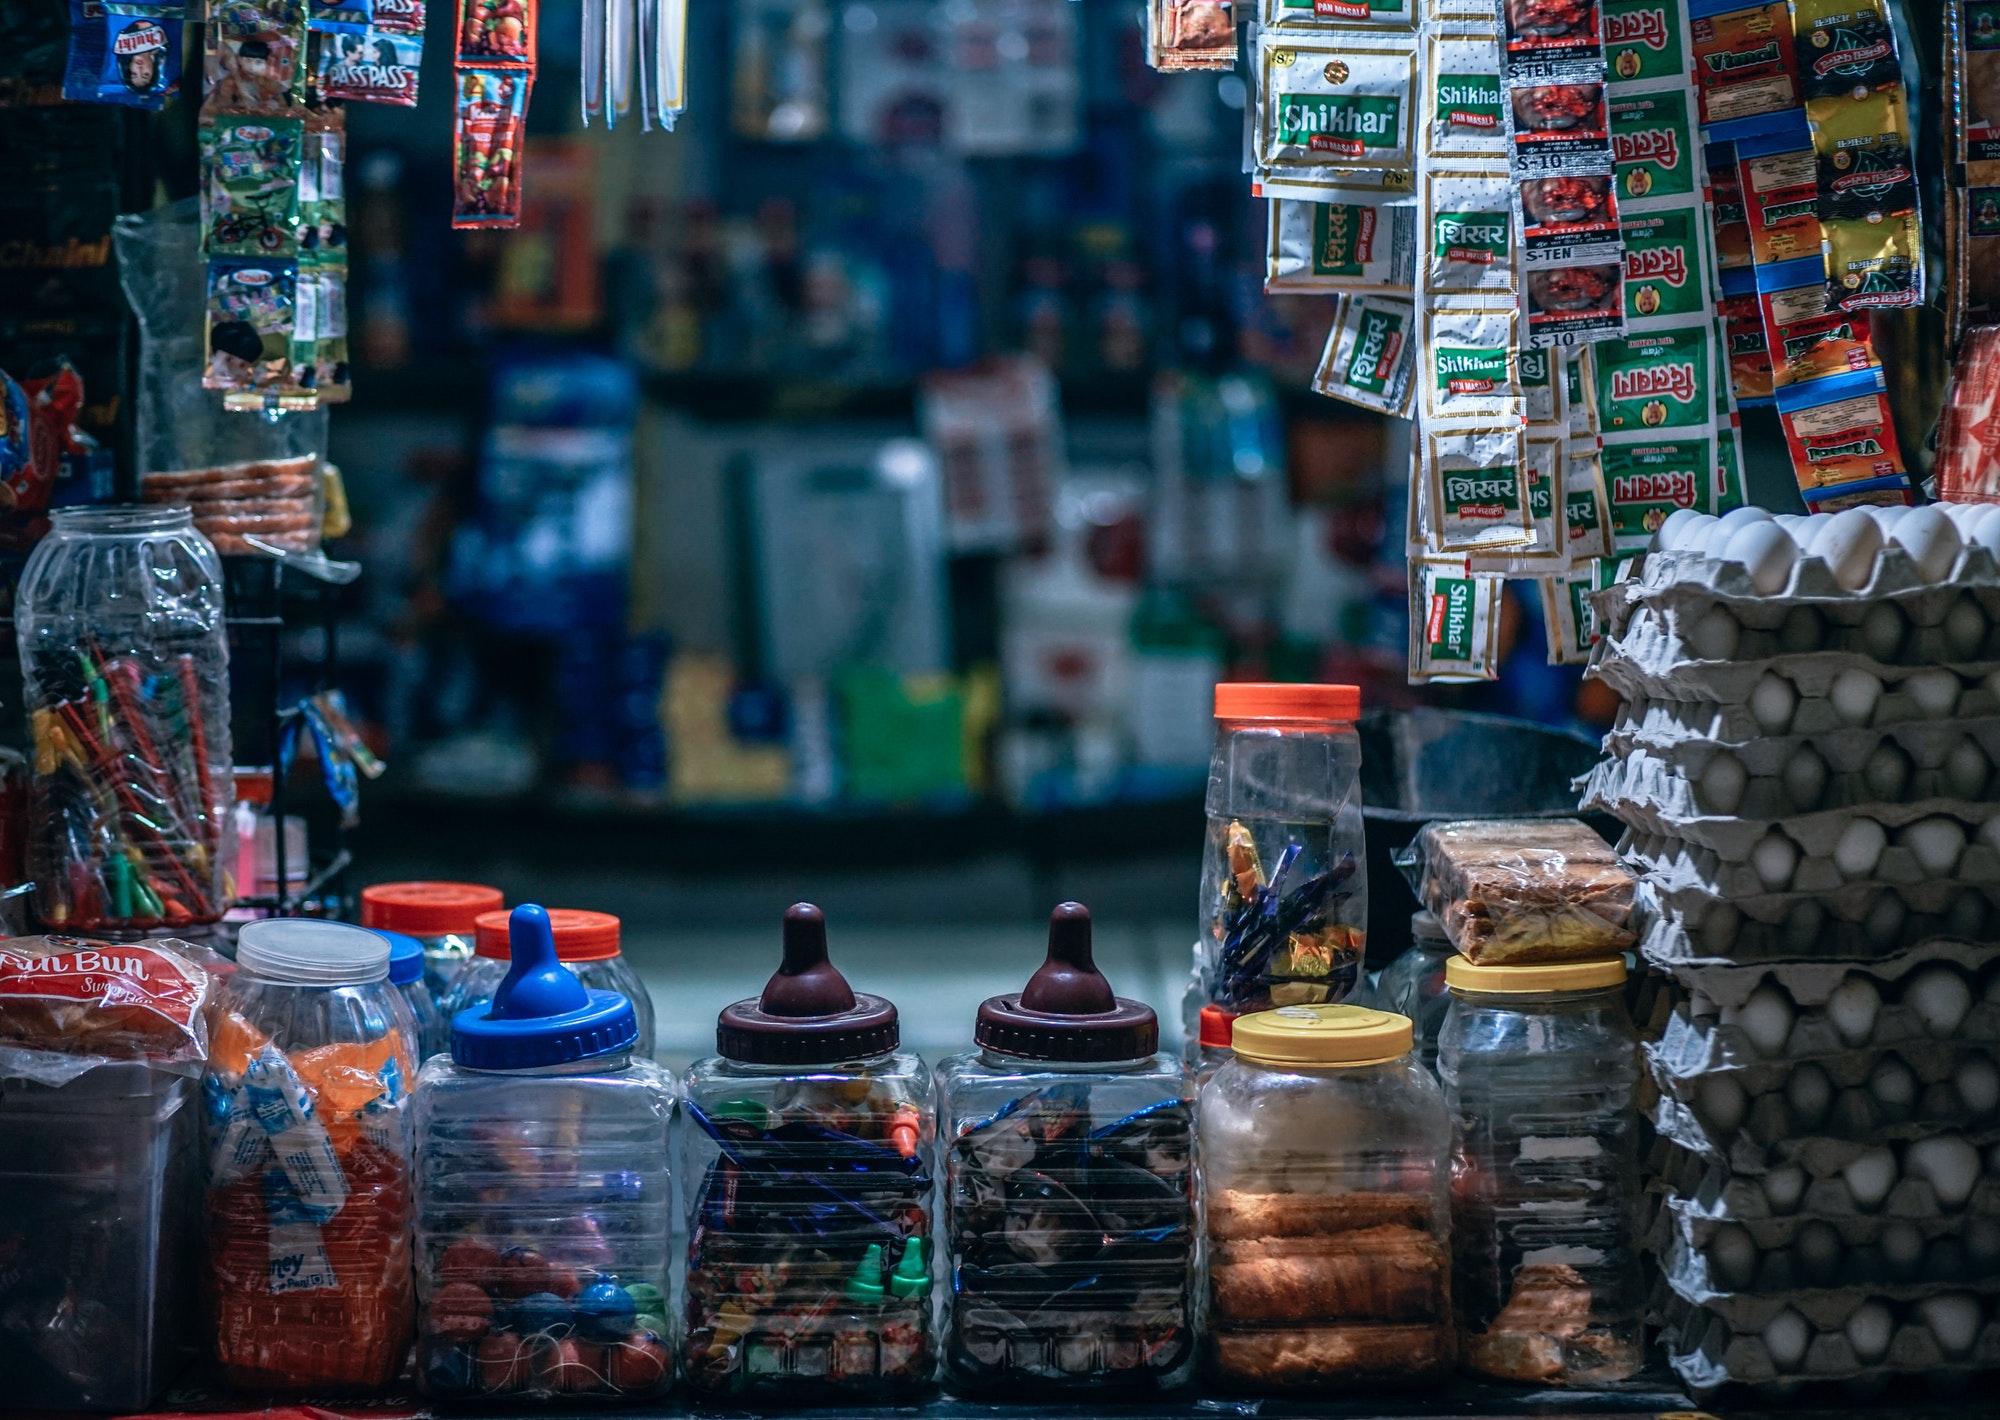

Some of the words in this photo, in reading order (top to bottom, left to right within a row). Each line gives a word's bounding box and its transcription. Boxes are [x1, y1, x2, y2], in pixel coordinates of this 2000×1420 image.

[1316, 2, 1336, 14] PAN
[1337, 4, 1369, 18] MASALA
[116, 30, 165, 53] Chutki
[1604, 11, 1667, 48] दिलबा
[1705, 42, 1780, 71] Vimal
[1508, 62, 1553, 78] S-TEN
[1283, 104, 1393, 136] Shikhar
[1451, 113, 1466, 123] PAN
[1466, 115, 1494, 126] MASALA
[1311, 140, 1331, 151] PAN
[1331, 142, 1362, 154] MASALA
[1615, 130, 1677, 167] दिलबा
[1518, 154, 1561, 170] S-10
[1761, 198, 1819, 226] imal
[1437, 220, 1506, 244] शिखर
[1526, 247, 1573, 262] S-TEN
[1350, 315, 1388, 384] शिखर
[1530, 333, 1575, 349] S-10
[1438, 356, 1504, 375] Shikhar
[1450, 381, 1467, 391] PAN
[1468, 380, 1493, 392] MASALA
[1613, 363, 1696, 403] दिलबाग
[1806, 438, 1883, 462] Vimal
[1446, 477, 1516, 501] शिखर
[1614, 471, 1696, 508] दिलबाग
[1448, 583, 1467, 655] Shikhar
[73, 951, 150, 982] Bun
